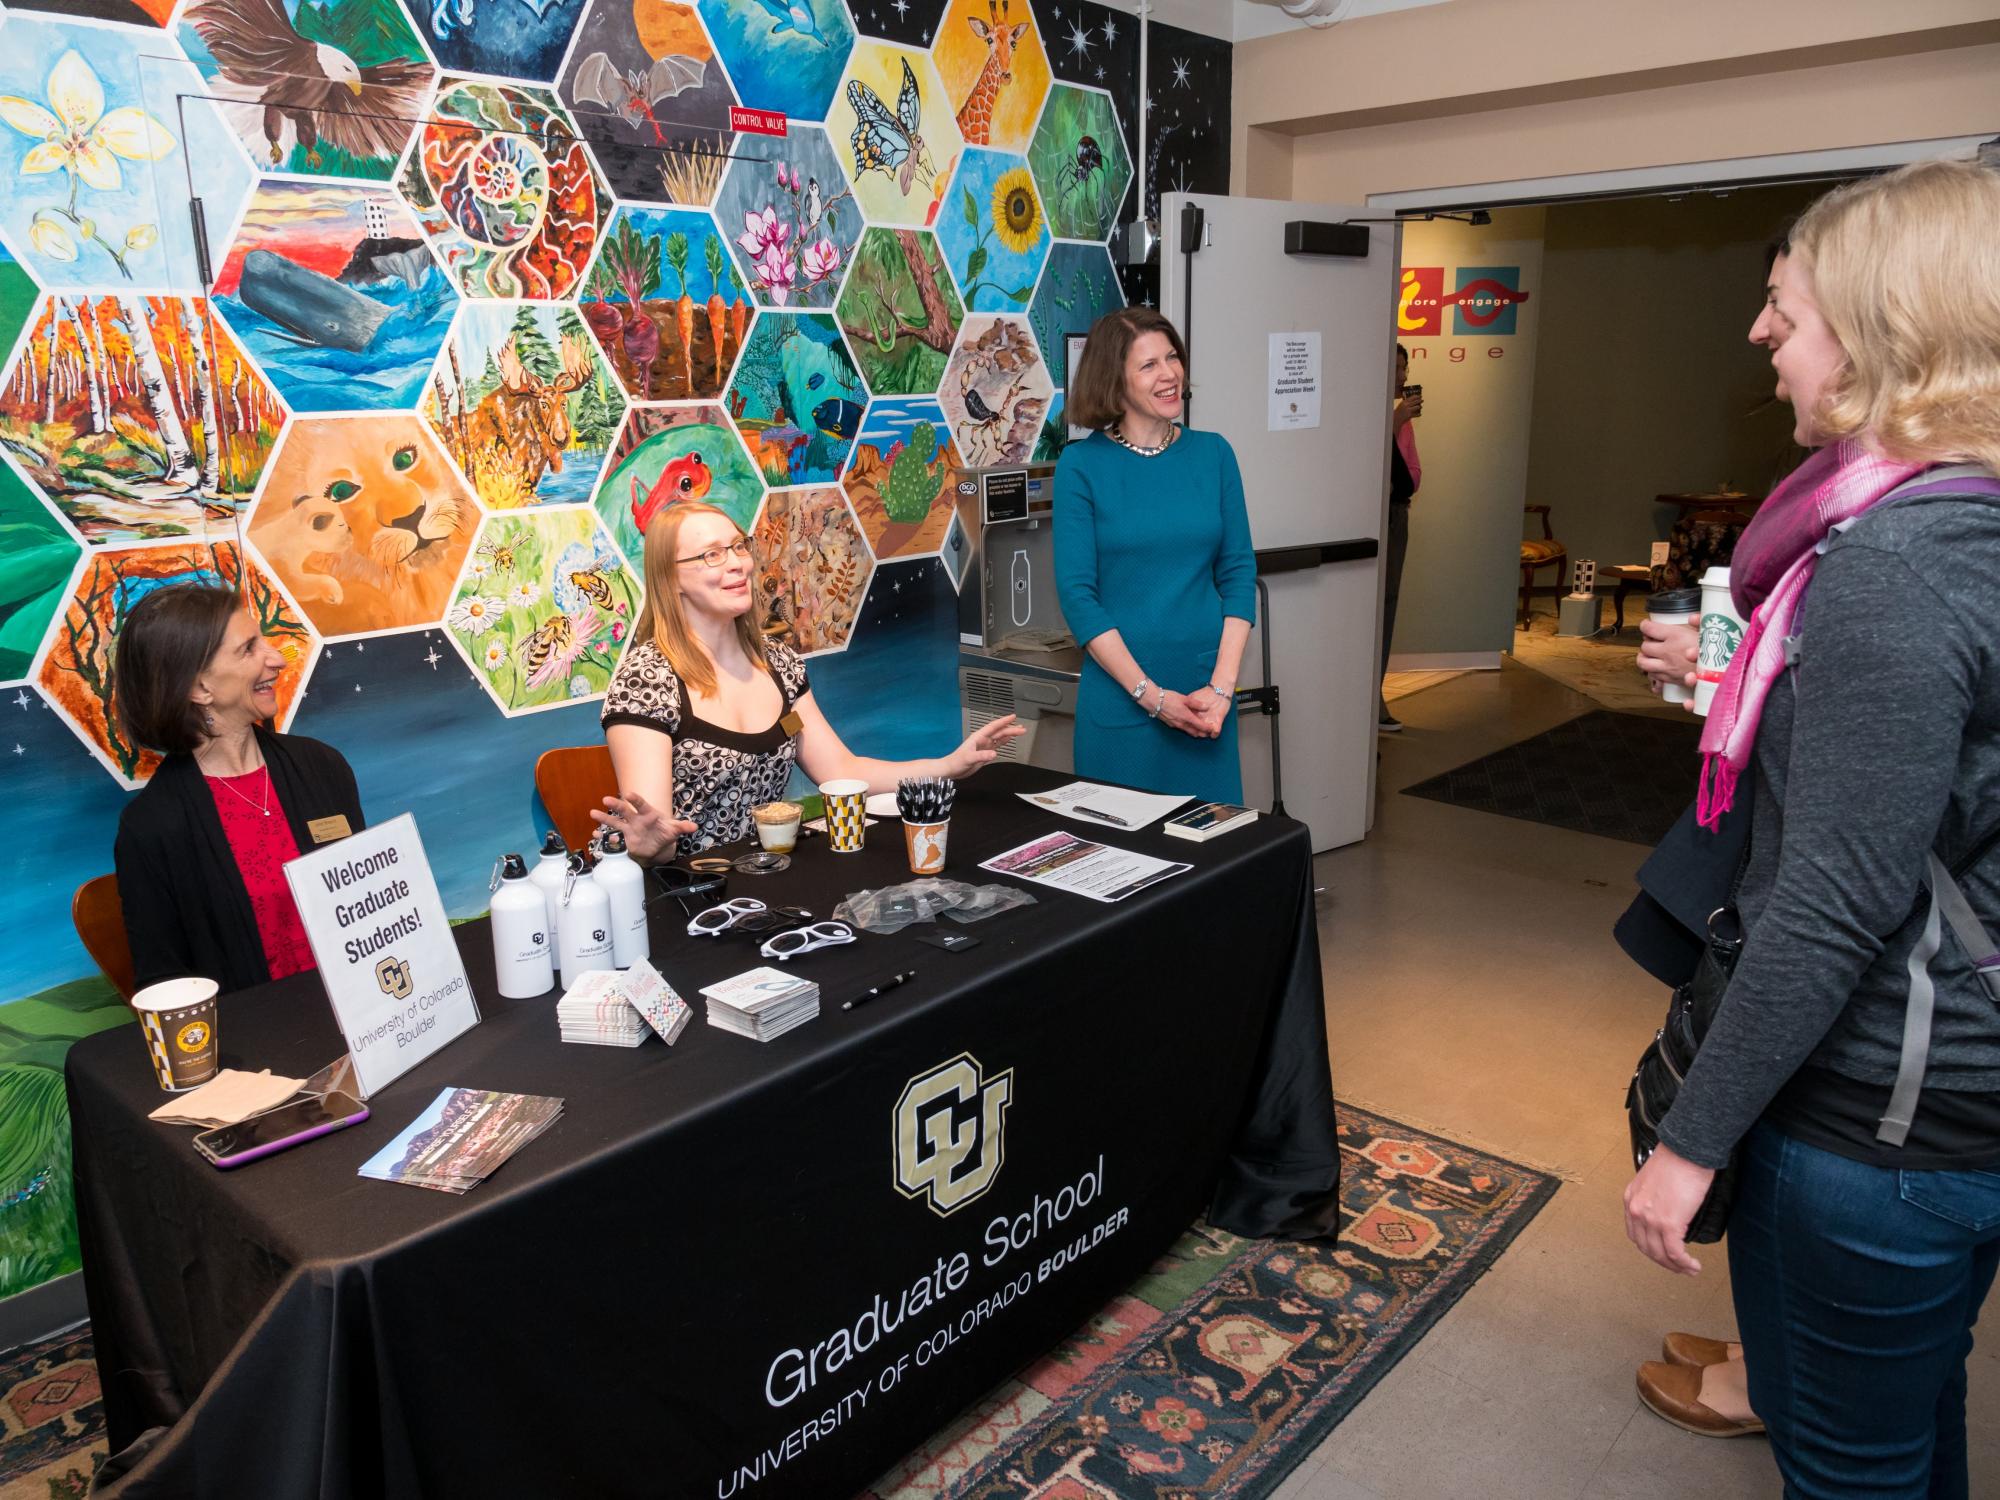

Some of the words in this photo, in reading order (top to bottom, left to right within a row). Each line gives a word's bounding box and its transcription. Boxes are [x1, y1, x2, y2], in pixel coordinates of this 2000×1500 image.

[733, 113, 763, 128] CONTROL
[766, 117, 784, 130] VALVE
[1458, 298, 1510, 307] engage
[1275, 387, 1301, 395] Appreciation
[321, 846, 398, 893] Welcome
[336, 878, 410, 928] Graduate
[344, 907, 422, 964] Students!
[352, 1013, 405, 1053] University
[407, 1000, 417, 1016] of
[419, 976, 464, 1011] Colorado
[396, 1014, 437, 1048] Boulder
[893, 1051, 1013, 1218] CU
[765, 1252, 969, 1408] Graduate
[983, 1154, 1103, 1267] School
[718, 1383, 873, 1500] UNIVERSITY
[879, 1354, 909, 1393] OF
[915, 1271, 1031, 1367] COLORADO
[1037, 1206, 1129, 1283] BOULDER
